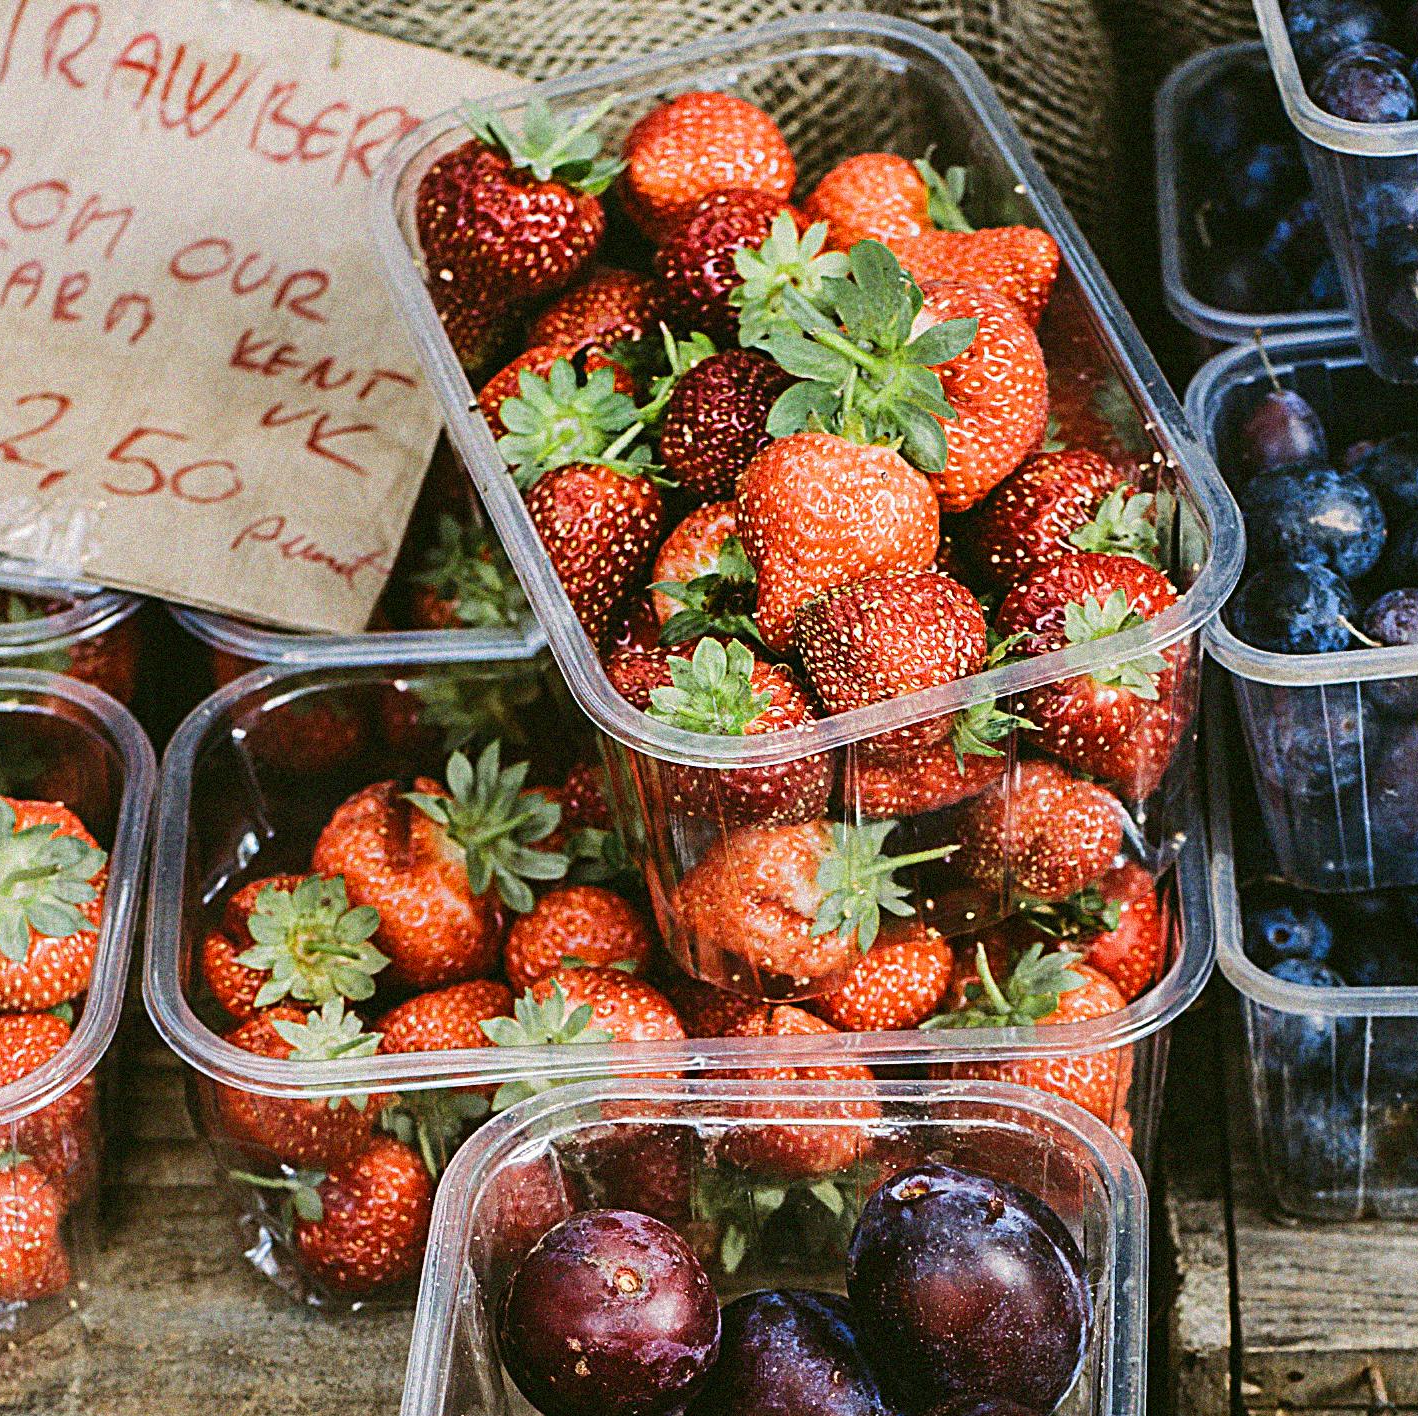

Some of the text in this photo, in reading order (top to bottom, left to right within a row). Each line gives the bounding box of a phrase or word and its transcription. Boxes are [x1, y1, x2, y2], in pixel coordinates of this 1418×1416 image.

[168, 238, 330, 323] OUR
[231, 331, 417, 399] KENT
[261, 405, 373, 473] UK
